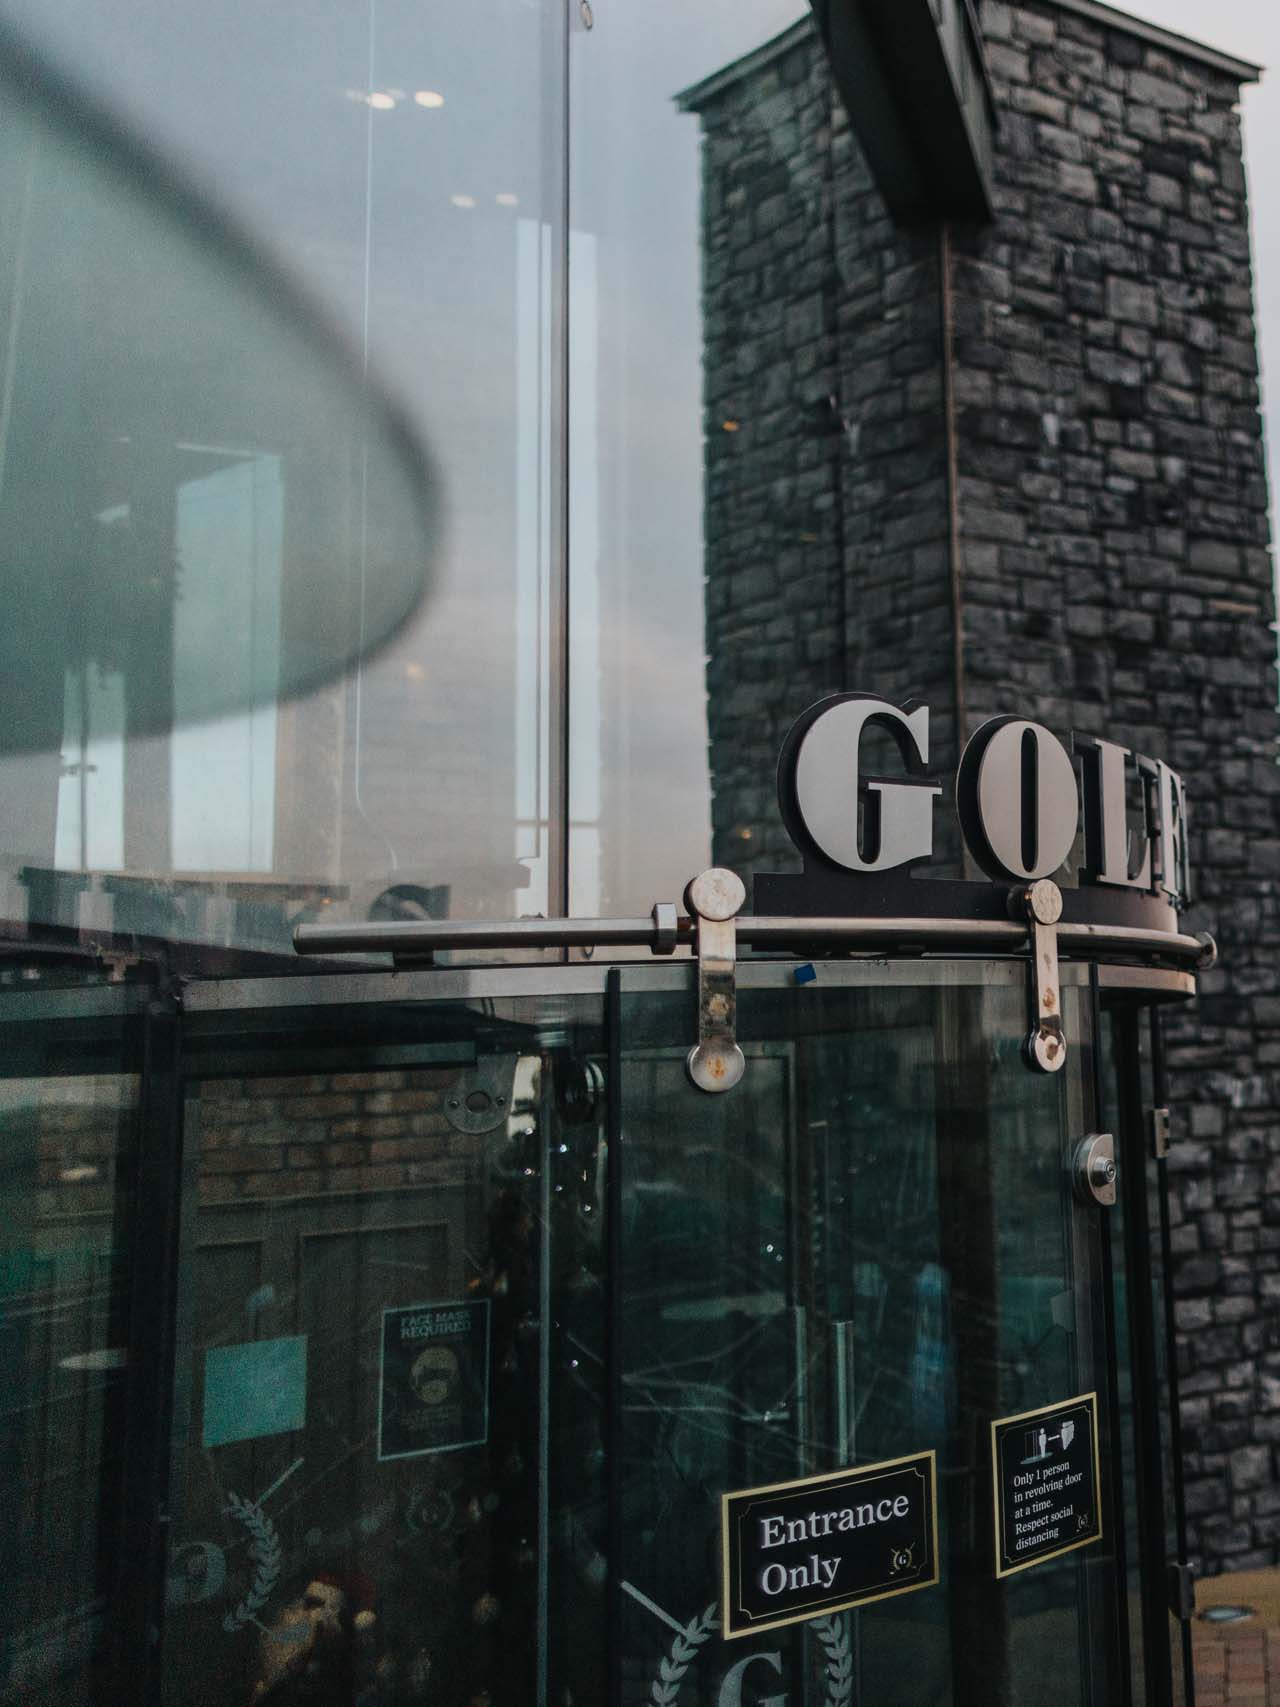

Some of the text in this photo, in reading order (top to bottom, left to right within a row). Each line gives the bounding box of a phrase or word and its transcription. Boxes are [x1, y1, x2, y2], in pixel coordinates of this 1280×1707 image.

[778, 692, 1186, 898] GOLF
[1013, 1461, 1070, 1487] Only 1 person
[1014, 1472, 1083, 1504] in revolving door
[760, 1495, 910, 1549] Entrance
[1014, 1508, 1024, 1519] at
[1025, 1506, 1031, 1515] a
[1016, 1504, 1074, 1535] Respect social
[1016, 1527, 1060, 1551] distancing
[761, 1554, 842, 1595] Only
[717, 1650, 790, 1707] G
